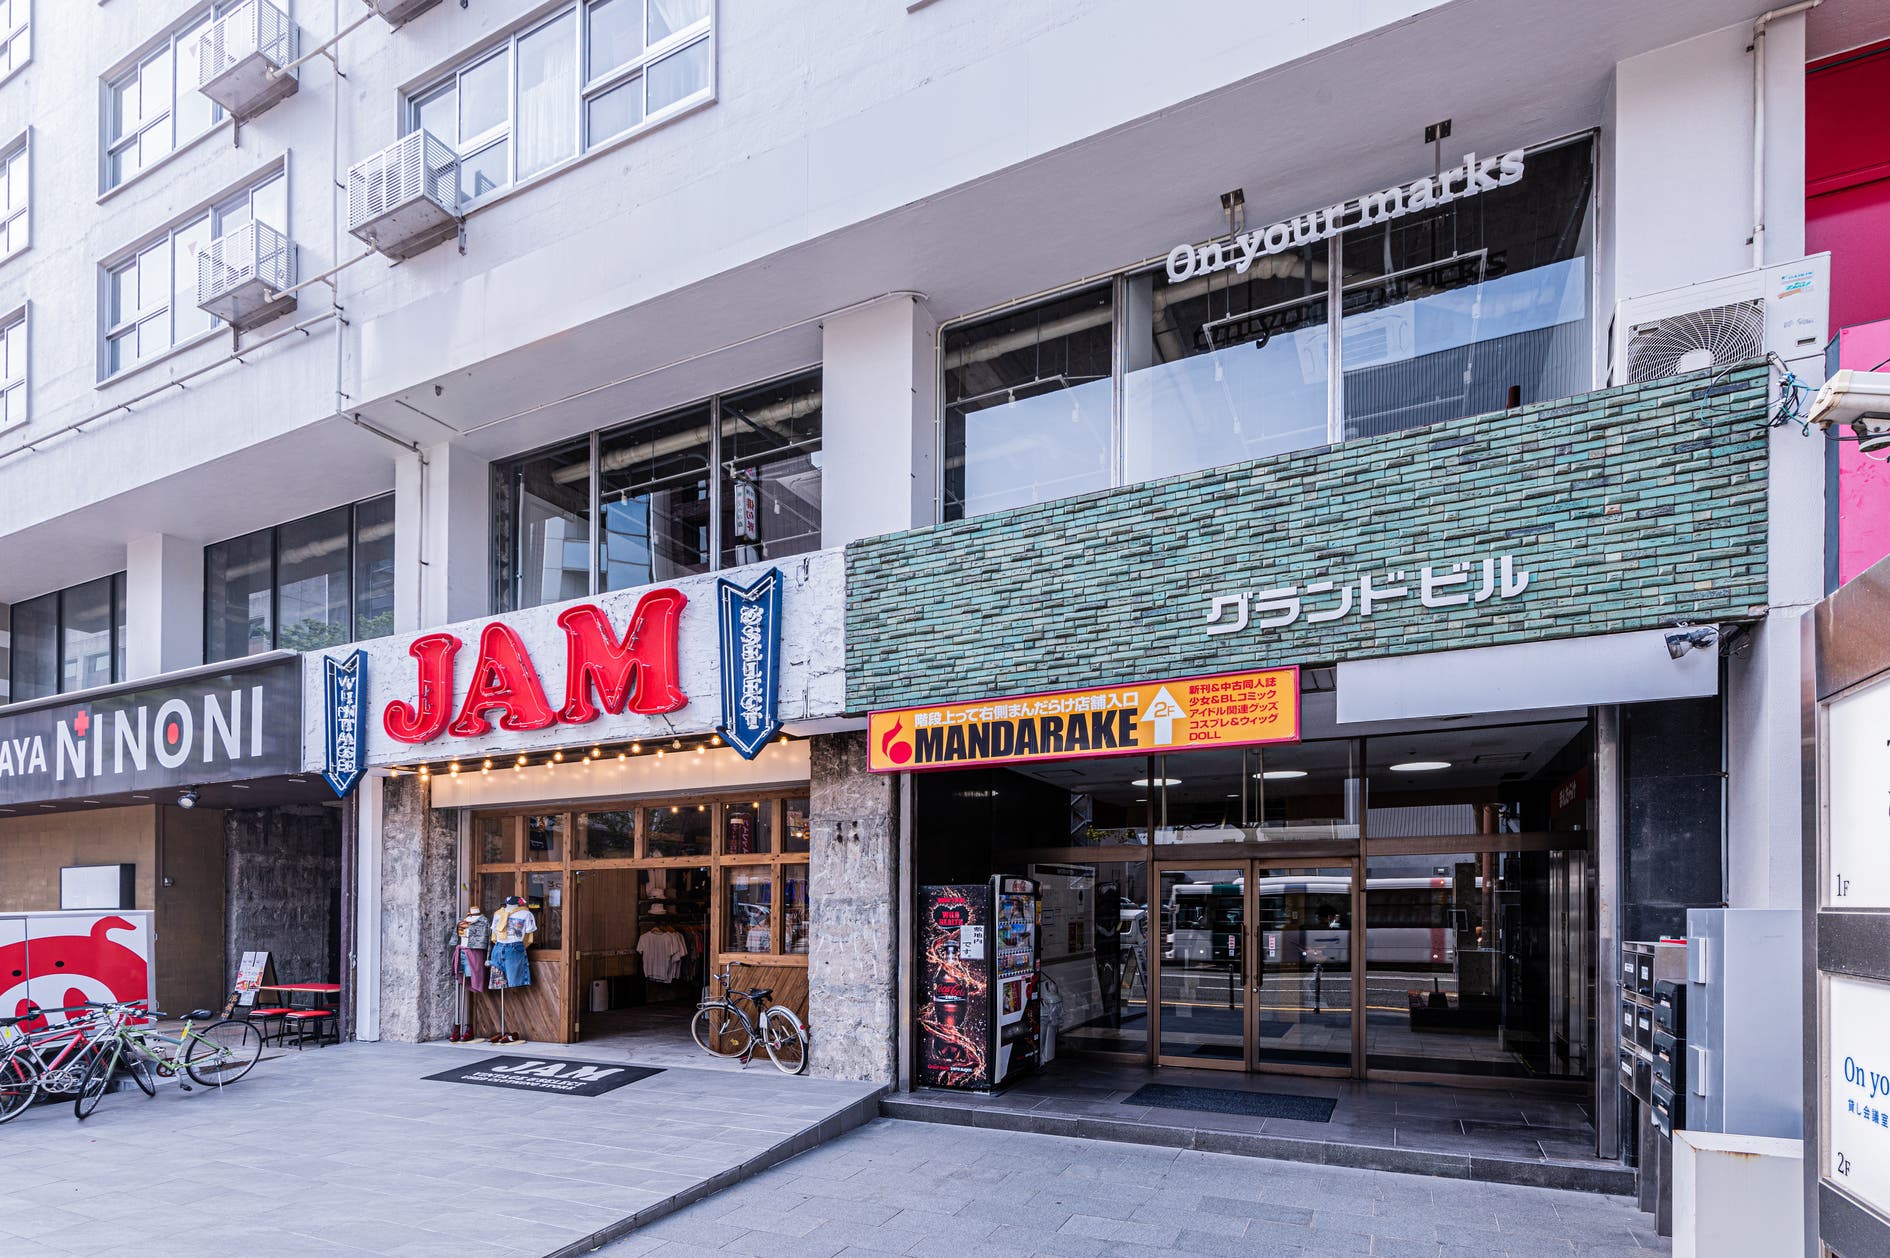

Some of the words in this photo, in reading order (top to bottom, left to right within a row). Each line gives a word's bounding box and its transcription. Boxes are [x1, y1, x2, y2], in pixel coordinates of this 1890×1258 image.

[1166, 244, 1226, 284] On
[1236, 204, 1344, 274] your
[1359, 150, 1525, 228] marks
[1207, 555, 1530, 636] グランドビル
[383, 588, 688, 743] JAM
[914, 691, 1139, 727] 階段上って右側まんだらけ店舗入口
[1154, 701, 1175, 717] 2F
[1189, 701, 1278, 718] アイドル関連グッズ
[914, 708, 1138, 763] MANDARAKE
[1189, 731, 1221, 741] DOLL
[1836, 873, 1850, 896] 1F
[491, 1061, 625, 1081] JAM
[1844, 1056, 1865, 1087] On
[1848, 1098, 1889, 1128] 貸し会議室
[1838, 1151, 1851, 1176] 2F
